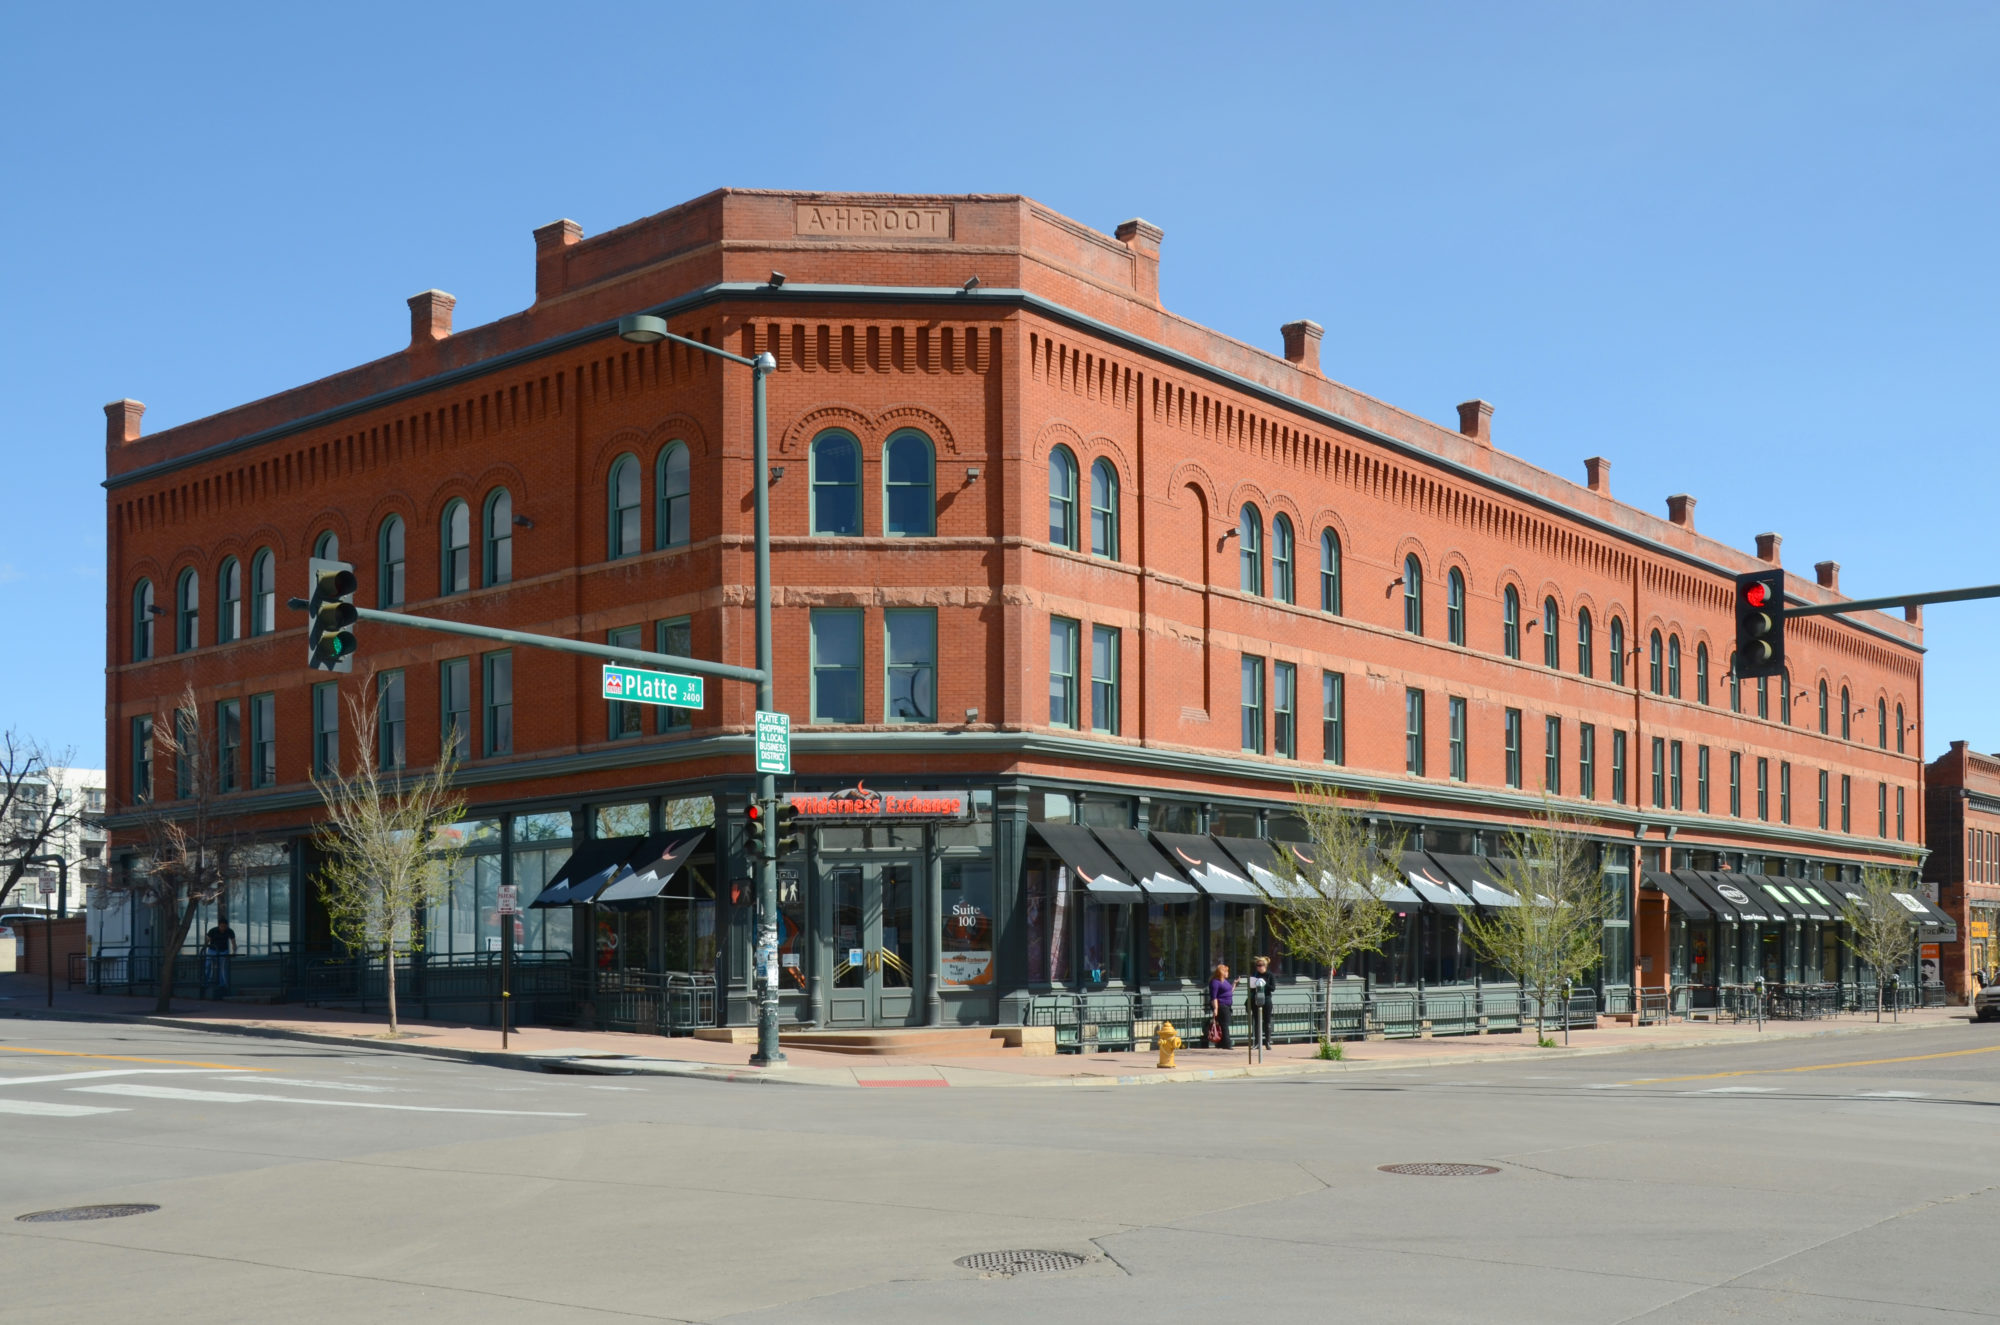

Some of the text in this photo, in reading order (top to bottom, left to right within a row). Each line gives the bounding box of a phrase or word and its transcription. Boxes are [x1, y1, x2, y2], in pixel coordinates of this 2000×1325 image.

[625, 675, 695, 700] Platte St
[683, 692, 700, 703] 2400
[758, 714, 787, 725] PLATTE ST
[759, 723, 786, 734] SHOPPING
[767, 734, 784, 743] LOCAL
[760, 742, 786, 752] BUSINESS
[761, 751, 785, 761] DISTRICT
[791, 795, 961, 814] Wilderness Exchange
[953, 904, 980, 915] Suite
[959, 916, 976, 927] 100
